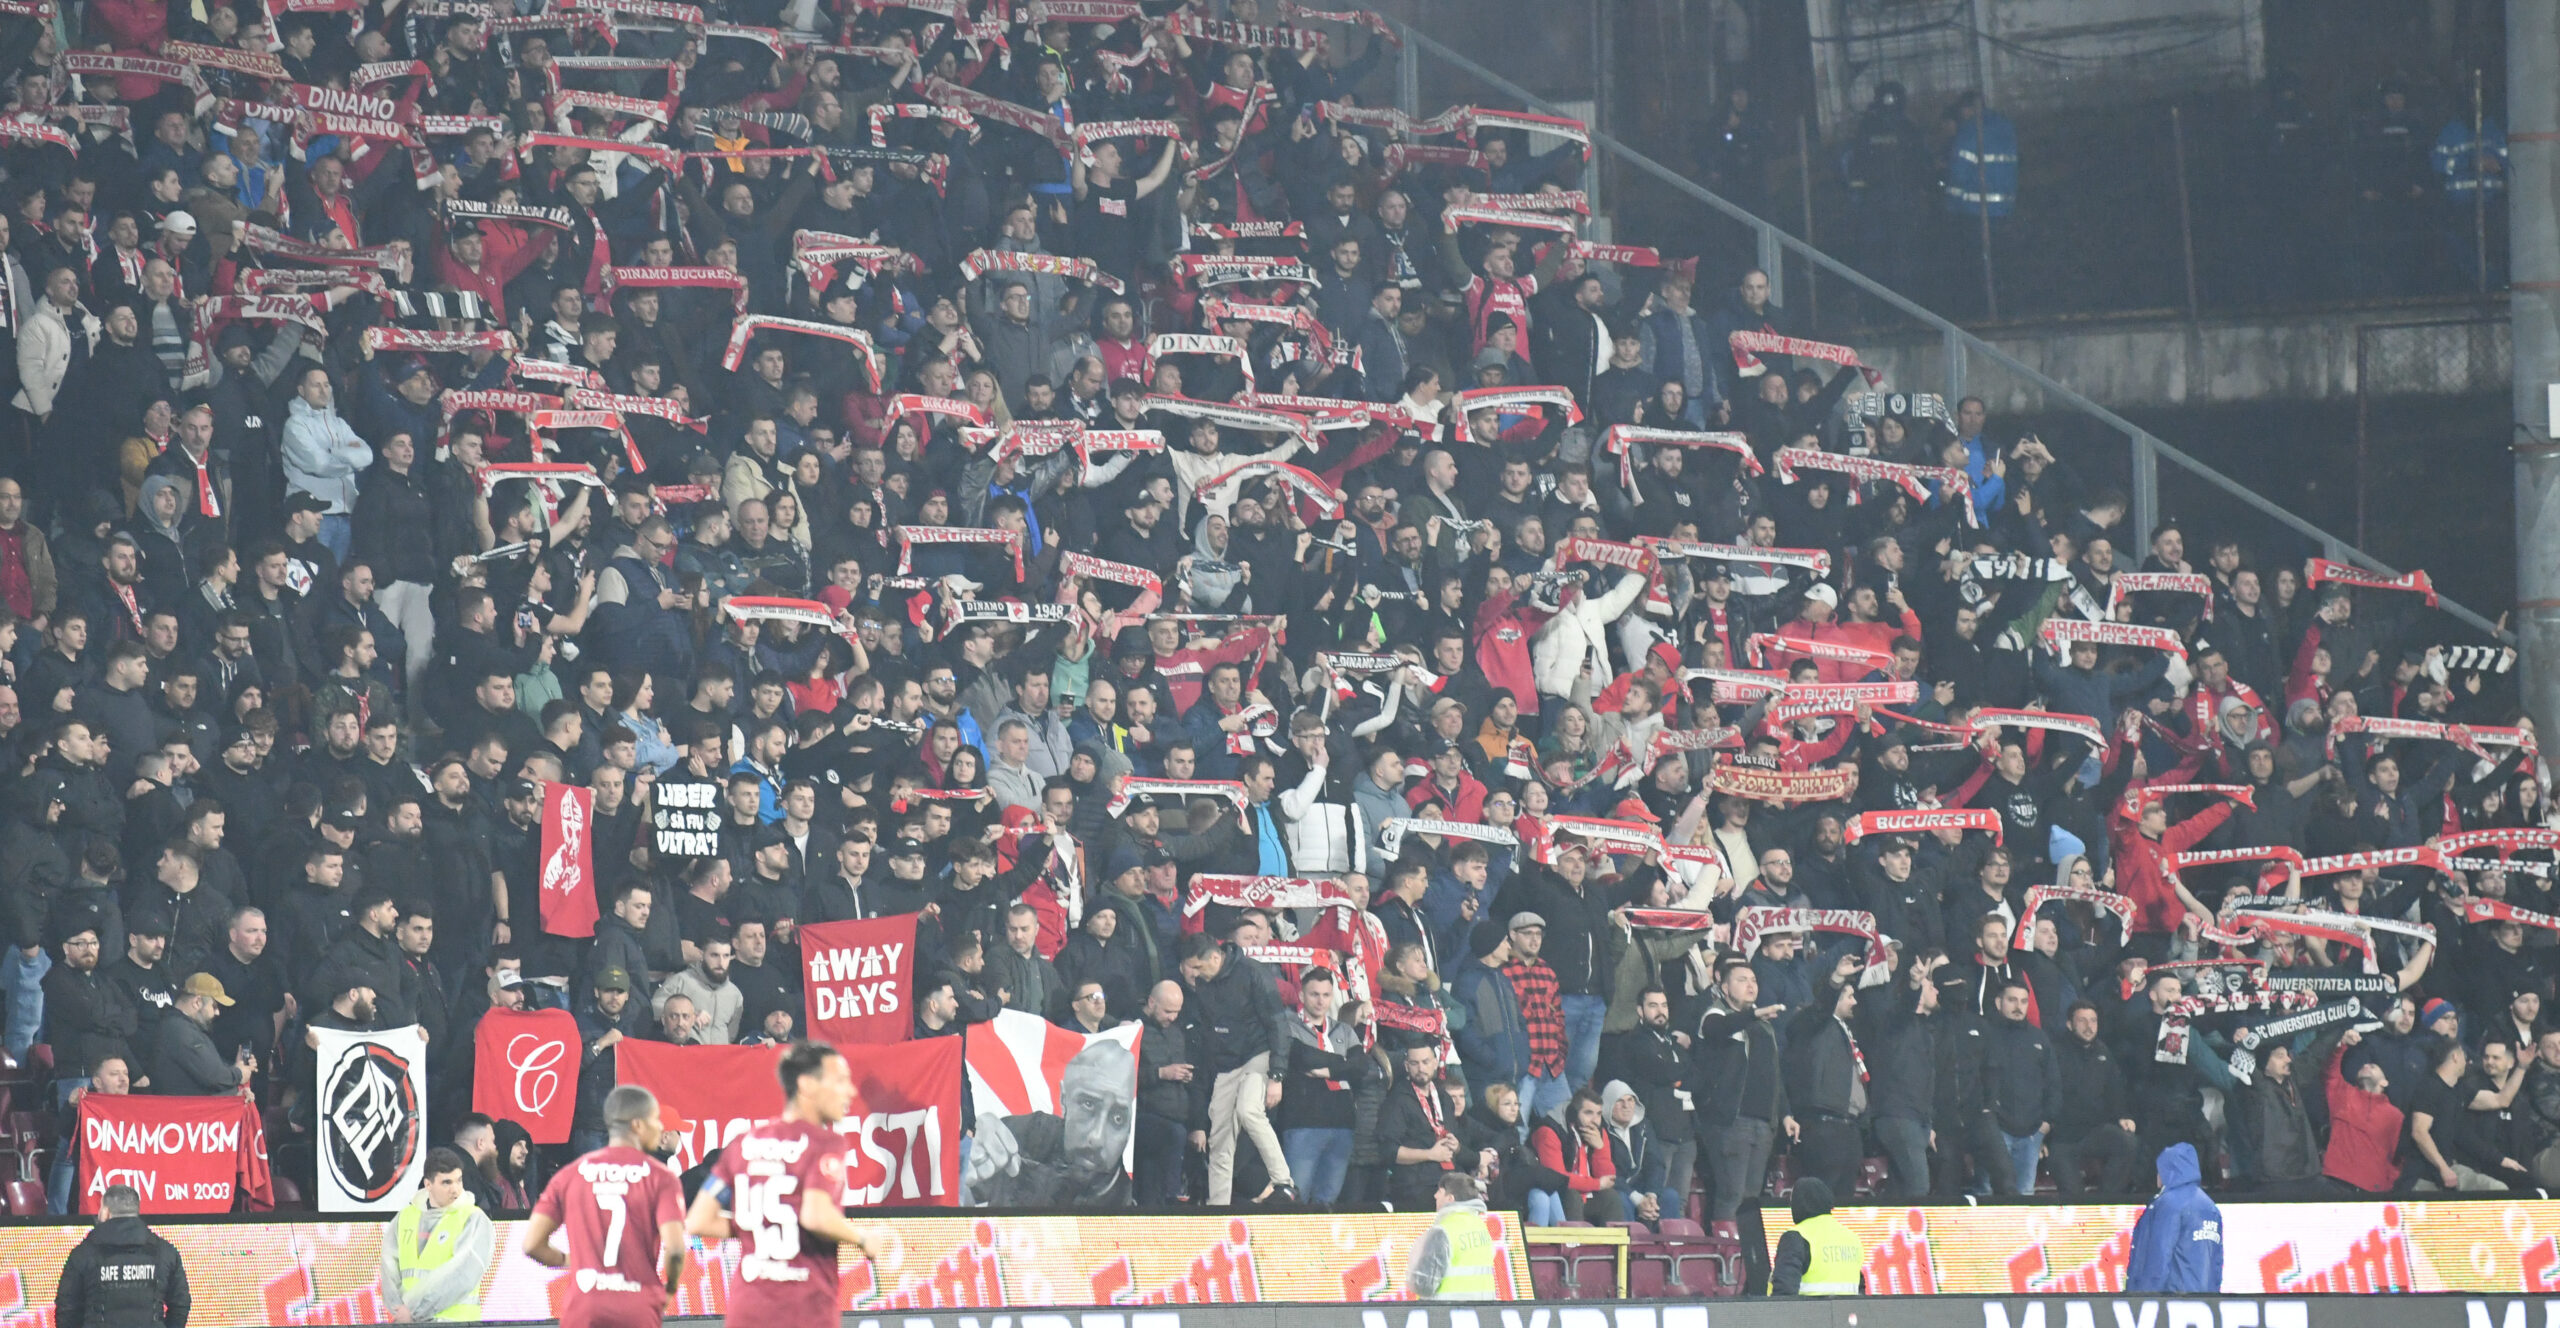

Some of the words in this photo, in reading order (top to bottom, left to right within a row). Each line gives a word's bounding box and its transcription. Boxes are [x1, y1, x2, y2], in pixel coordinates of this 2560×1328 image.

[306, 86, 397, 120] DINAMO
[325, 112, 401, 138] DINAMO
[617, 268, 669, 280] DINAMO
[452, 391, 532, 408] DINAMO
[920, 397, 971, 415] DINAMO
[550, 412, 606, 426] DINAMO
[1574, 539, 1644, 560] DINAMO
[966, 602, 1005, 612] DINAMO
[1034, 603, 1064, 619] 1948
[1777, 699, 1855, 721] DINAMO
[656, 783, 716, 809] LIBER
[1876, 813, 1987, 830] BUCURESTI
[2177, 846, 2272, 864] DINAMO
[810, 943, 903, 982] AWAY
[2354, 978, 2383, 992] CLUJ
[816, 981, 899, 1021] DAYS
[2255, 1025, 2268, 1039] FC
[2267, 1010, 2328, 1039] UNIVERSITATEA
[2327, 1004, 2347, 1022] CLUJ
[87, 1168, 156, 1199] ACTIV
[164, 1183, 190, 1201] DIN
[193, 1182, 230, 1201] 2003
[734, 1173, 802, 1261] 45
[597, 1194, 627, 1267] 7
[100, 1264, 119, 1282] SAFE
[122, 1263, 156, 1282] SECURITY
